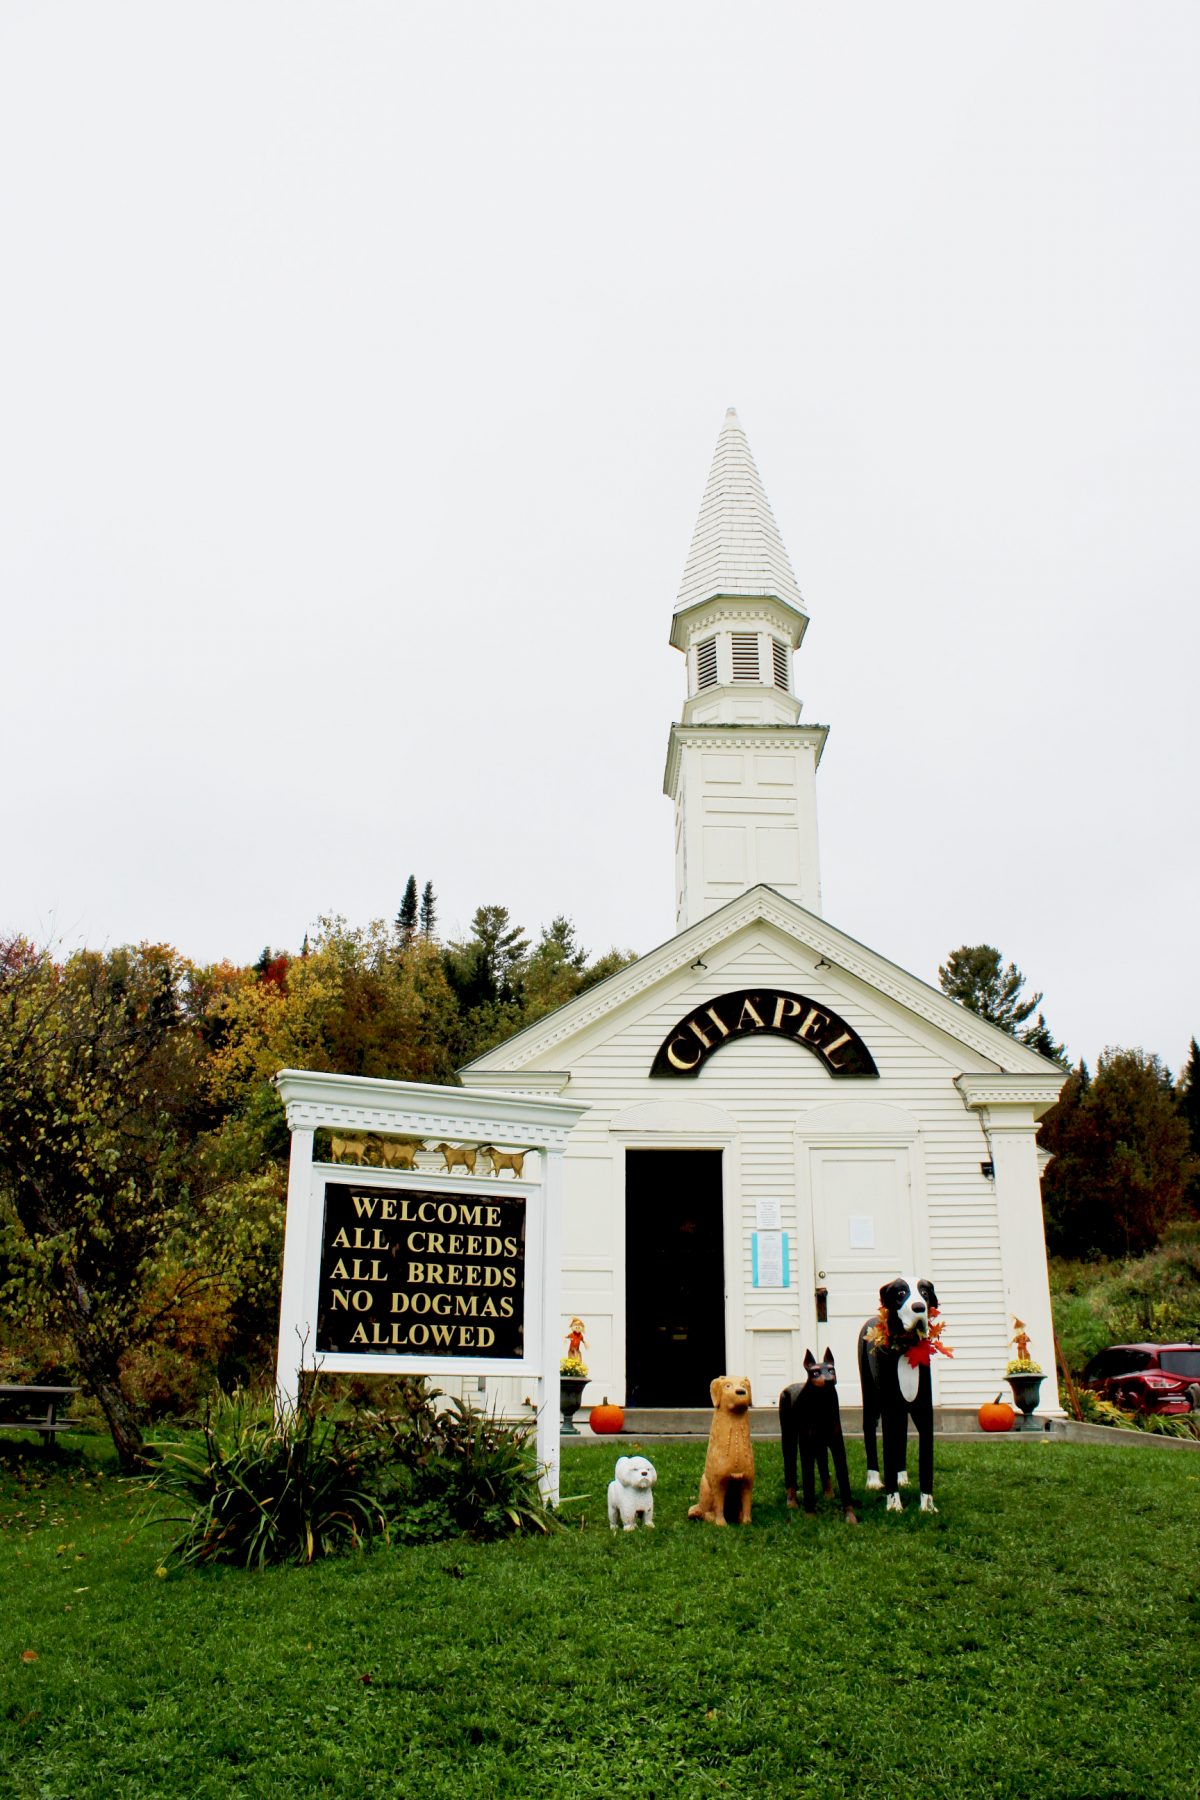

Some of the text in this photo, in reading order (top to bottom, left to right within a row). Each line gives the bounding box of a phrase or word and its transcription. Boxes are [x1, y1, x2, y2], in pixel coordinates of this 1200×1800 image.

[667, 996, 853, 1070] CHAPEL
[352, 1196, 501, 1227] WELCOME
[332, 1227, 517, 1257] ALL CREEDS
[330, 1258, 517, 1288] ALL BREEDS
[330, 1289, 514, 1318] NO DOGMAS
[349, 1322, 495, 1348] ALLOWED
